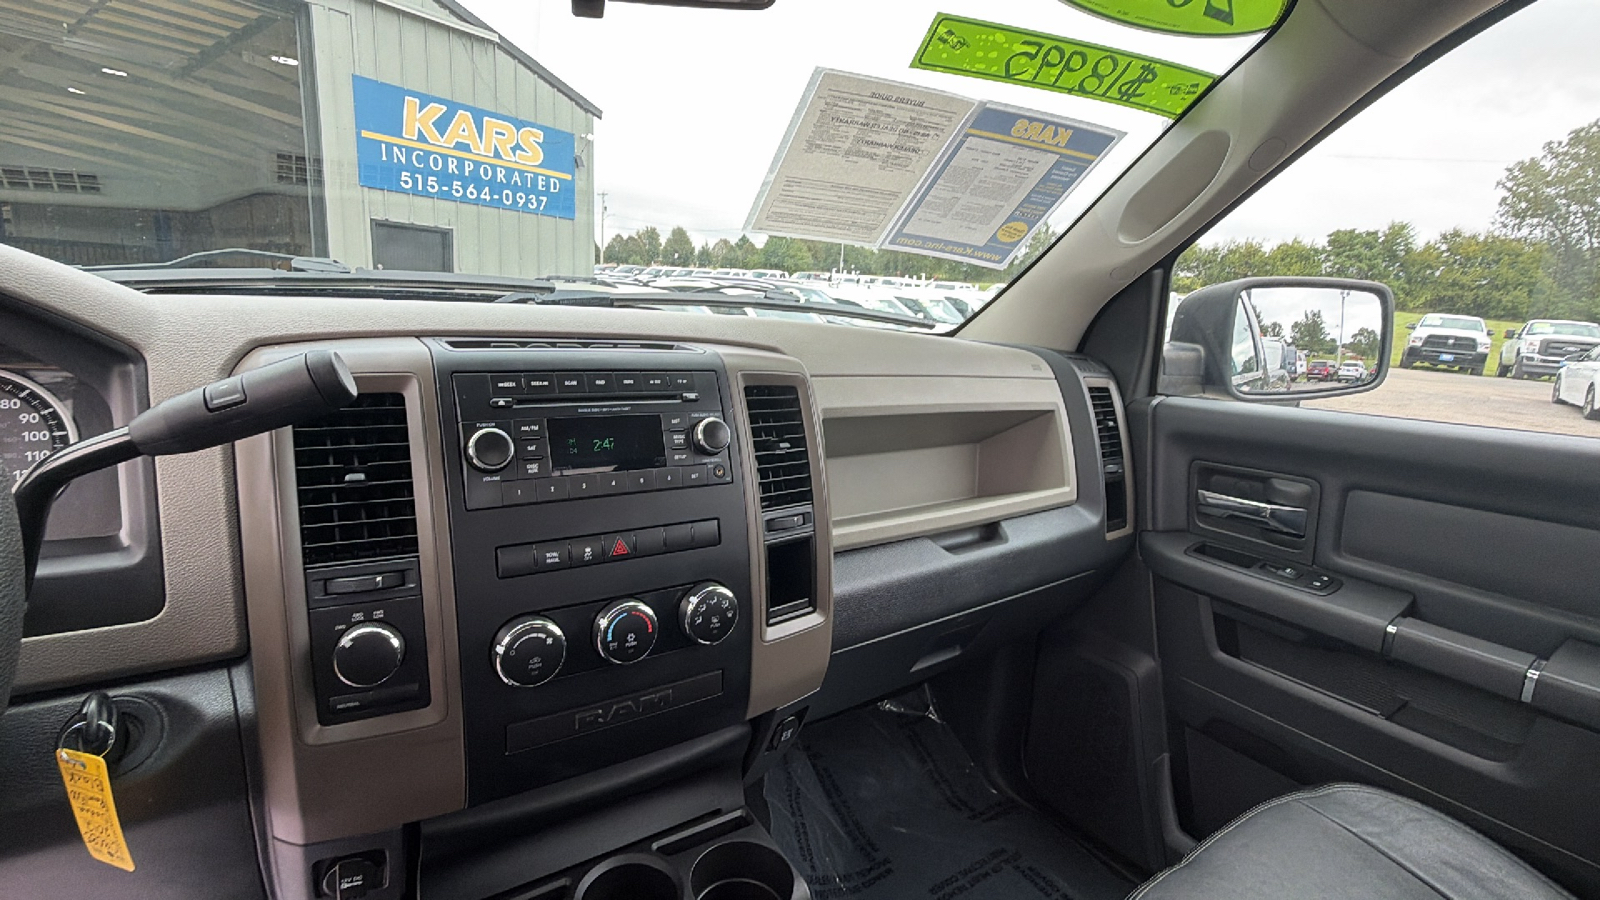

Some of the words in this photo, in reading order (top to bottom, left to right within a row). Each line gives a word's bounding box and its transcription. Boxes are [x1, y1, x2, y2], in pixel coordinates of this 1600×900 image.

[402, 95, 545, 167] KARS
[381, 143, 561, 193] INCORPORATED
[400, 171, 548, 211] 515-564-0937
[0, 398, 21, 409] 80
[19, 412, 40, 424] 90
[21, 431, 50, 442] 100
[593, 437, 614, 452] 2:47
[575, 688, 673, 730] RAM
